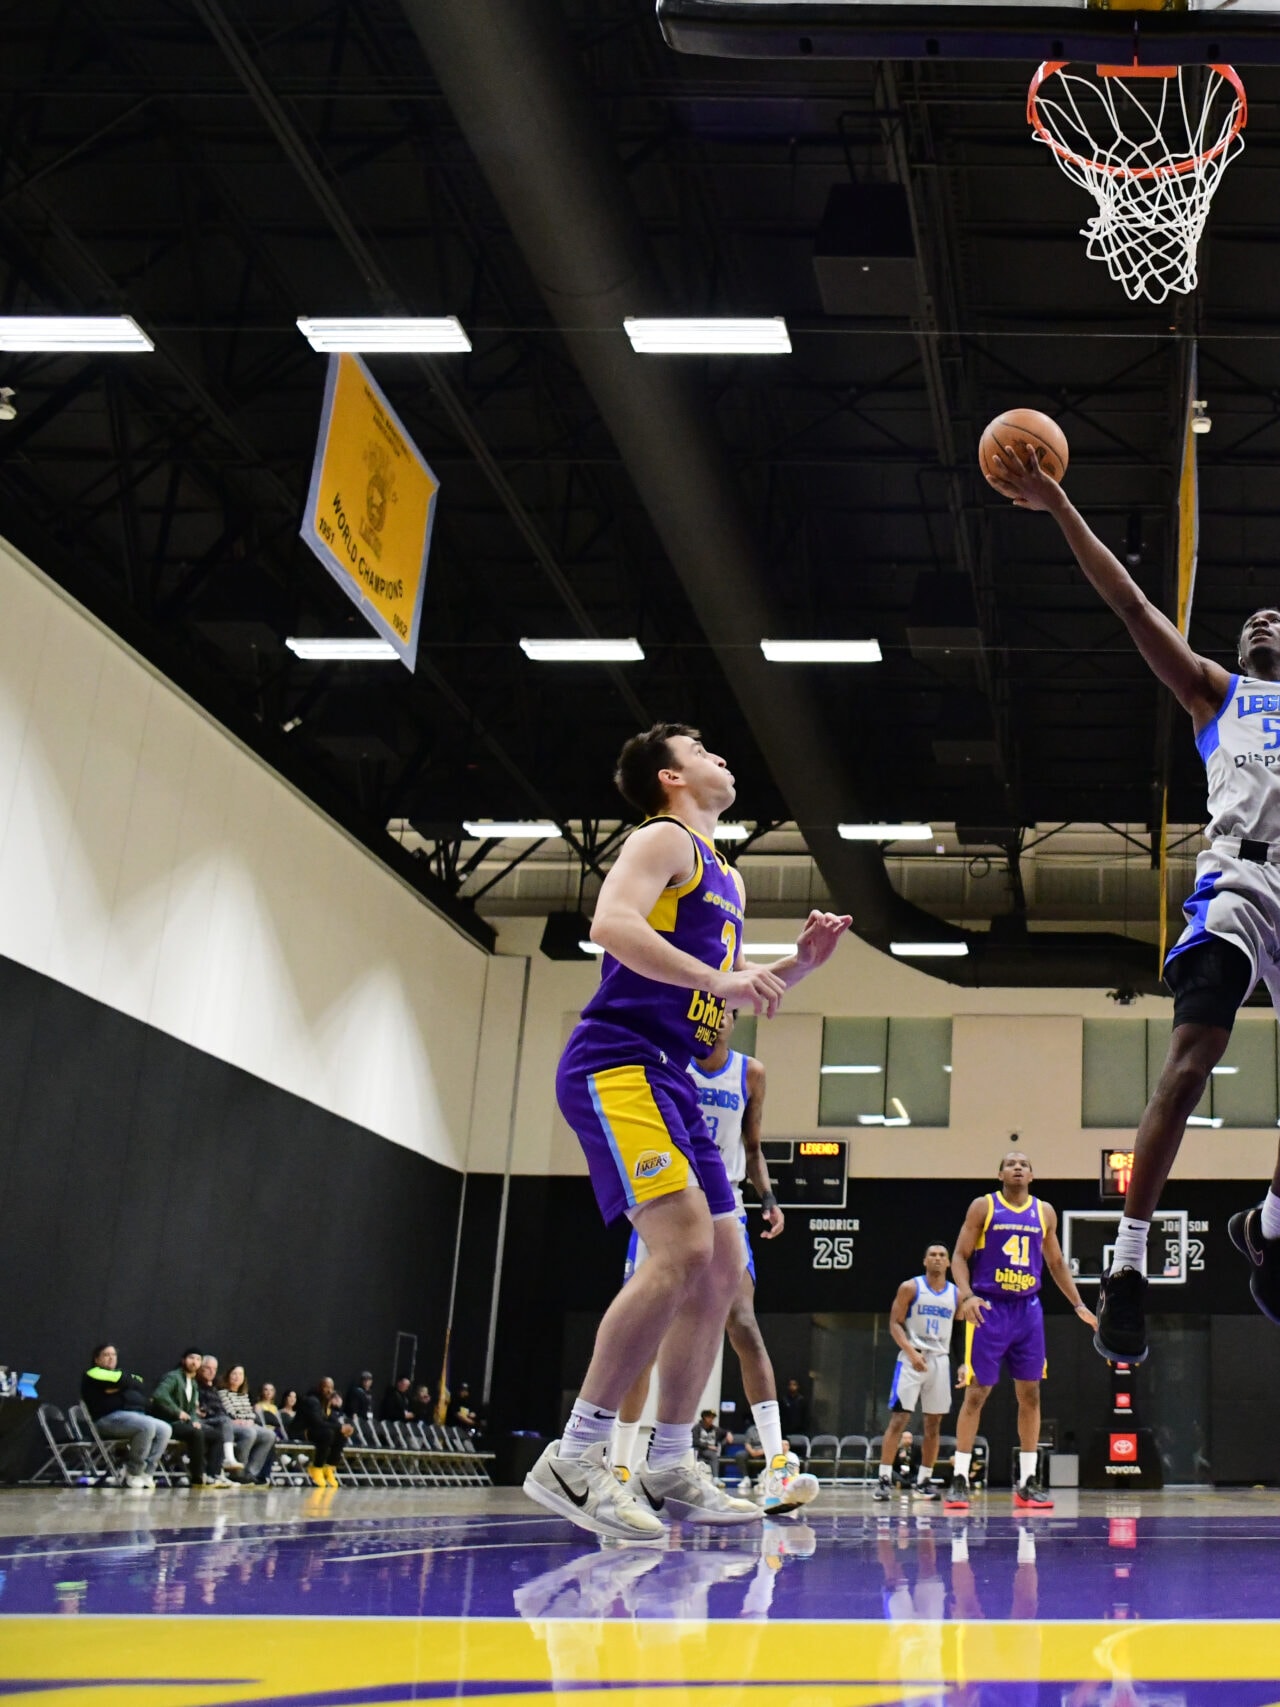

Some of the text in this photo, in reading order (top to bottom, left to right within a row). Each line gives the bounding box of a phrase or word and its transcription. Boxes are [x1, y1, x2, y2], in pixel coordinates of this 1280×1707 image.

[319, 518, 335, 545] 1951
[333, 492, 358, 562] WORLD
[358, 557, 403, 600] CHAMPIONS
[800, 1142, 839, 1155] LEGENDS
[809, 1219, 860, 1231] GOODRICH
[1161, 1220, 1209, 1232] JOHSON
[812, 1237, 854, 1269] 25
[1002, 1234, 1030, 1267] 41
[1165, 1239, 1205, 1271] 32
[995, 1268, 1036, 1290] bibigo
[926, 1318, 939, 1335] 14
[1105, 1465, 1142, 1475] TOYOTA
